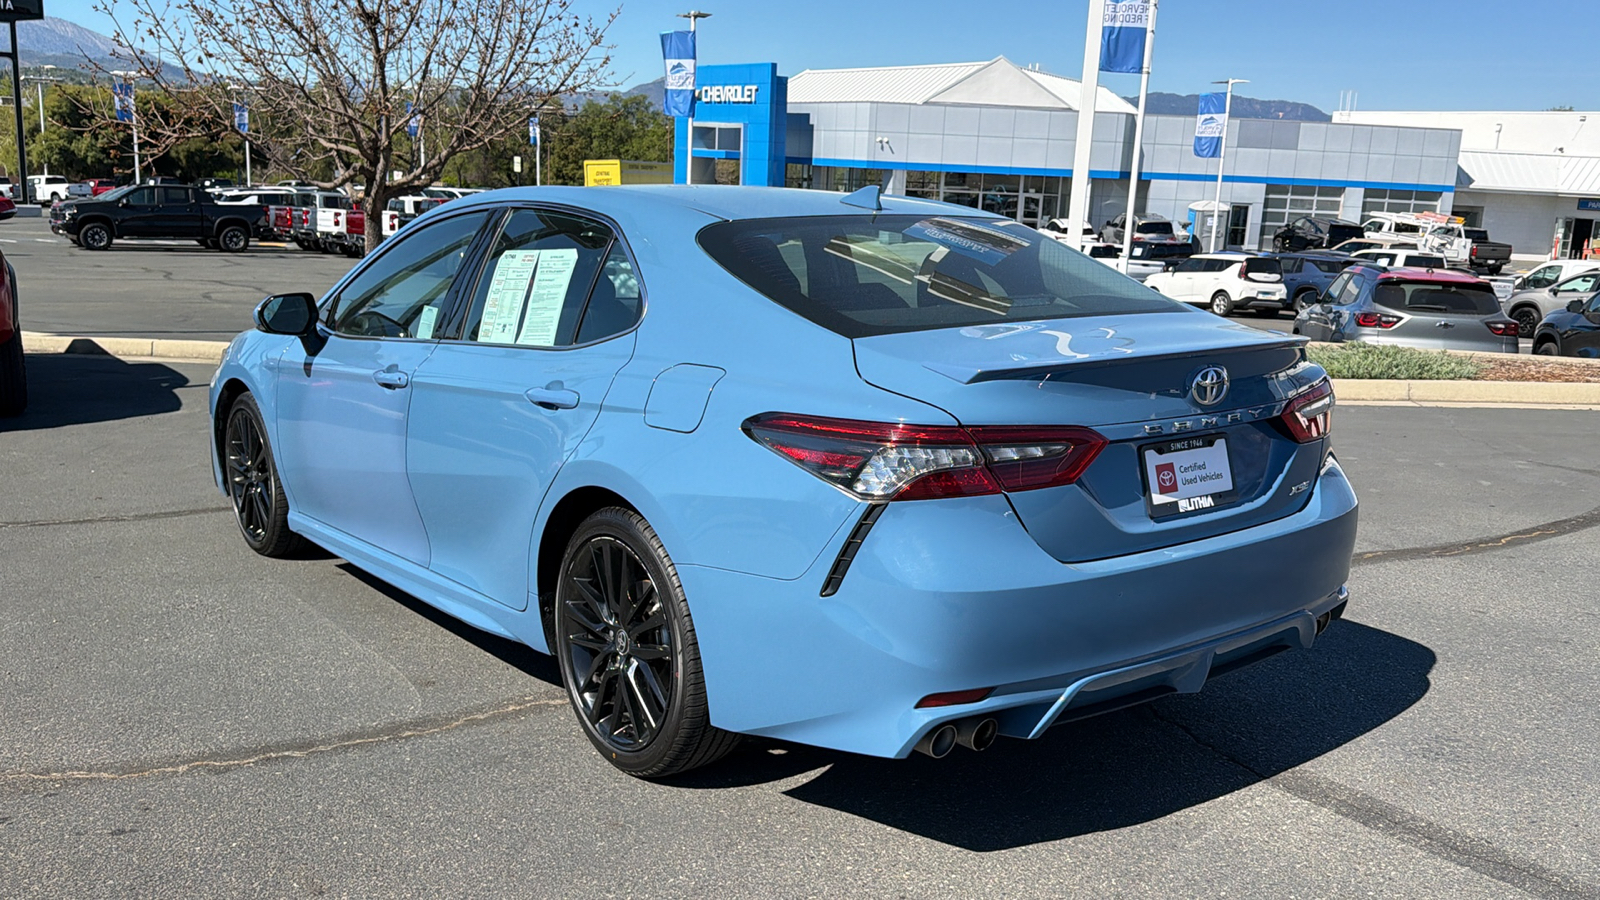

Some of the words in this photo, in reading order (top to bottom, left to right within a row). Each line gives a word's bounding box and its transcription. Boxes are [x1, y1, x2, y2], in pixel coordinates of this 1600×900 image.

[702, 85, 757, 102] CHEVROLET
[1144, 409, 1263, 433] CAMRY
[1170, 441, 1188, 450] SINCE
[1190, 439, 1203, 448] 1946
[1179, 461, 1206, 473] Certified
[1181, 476, 1198, 486] Used
[1199, 471, 1223, 483] Vehicles
[1185, 495, 1214, 510] LITHIA
